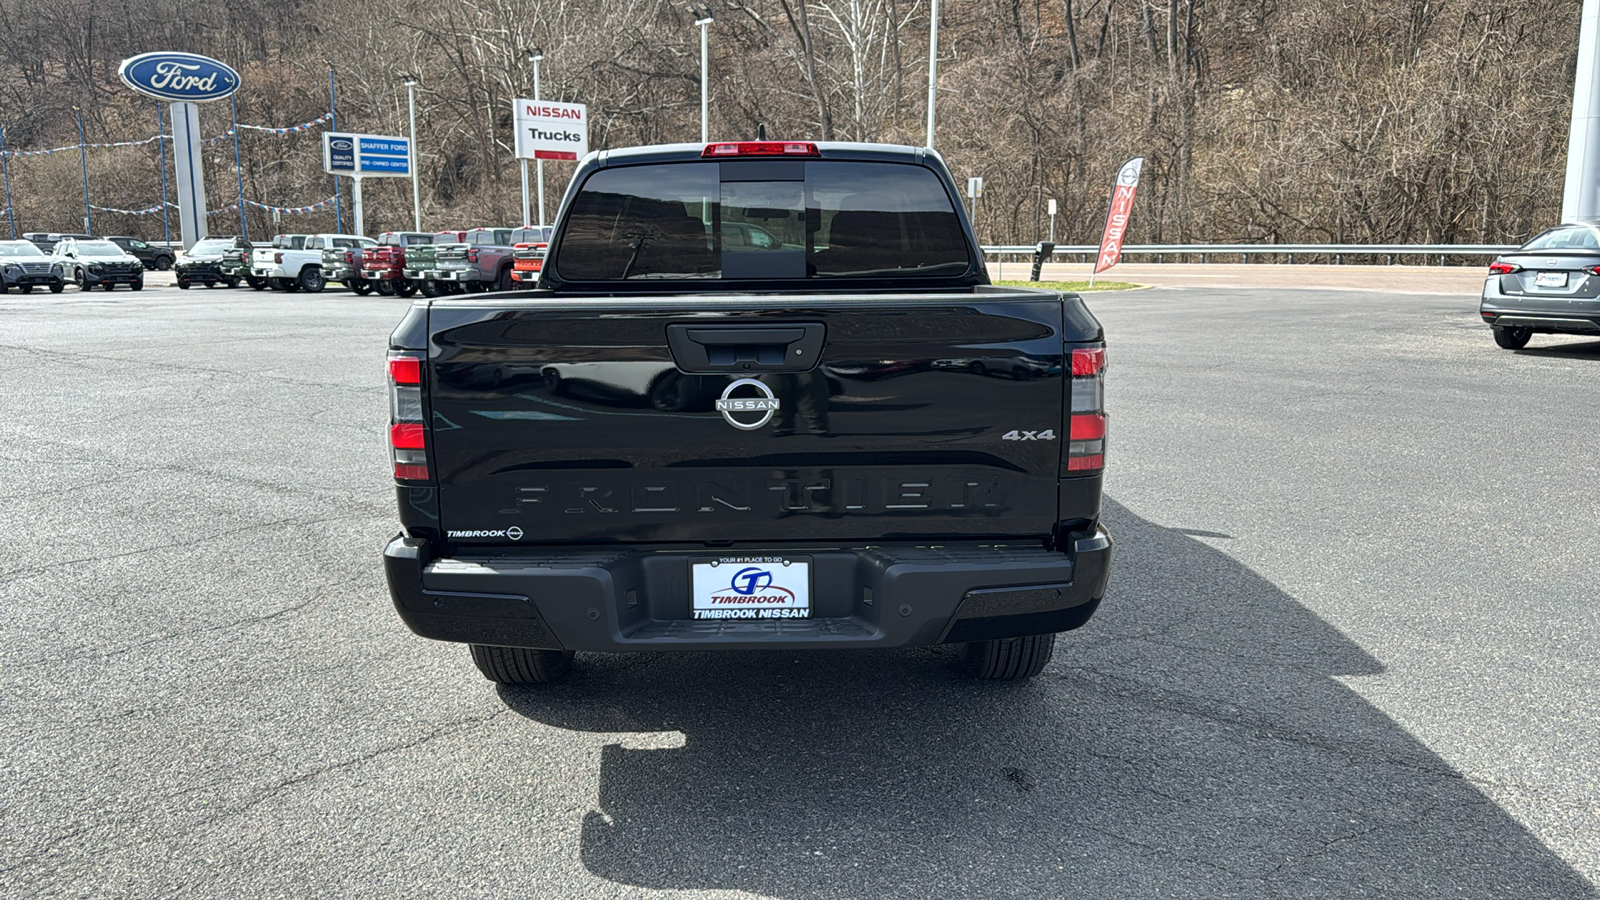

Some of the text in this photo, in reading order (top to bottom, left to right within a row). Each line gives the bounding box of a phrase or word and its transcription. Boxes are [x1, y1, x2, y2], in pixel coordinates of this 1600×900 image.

[150, 61, 218, 92] Ford
[526, 105, 581, 119] NISSAN
[528, 127, 581, 142] Trucks
[360, 142, 408, 152] SHAFFER FORD
[1102, 187, 1134, 266] NISSAN
[717, 401, 778, 409] NISSAN
[499, 475, 1001, 514] FRONTIER
[710, 596, 788, 604] TIMBROOK
[693, 608, 810, 619] TIMBROOK NISSAN
